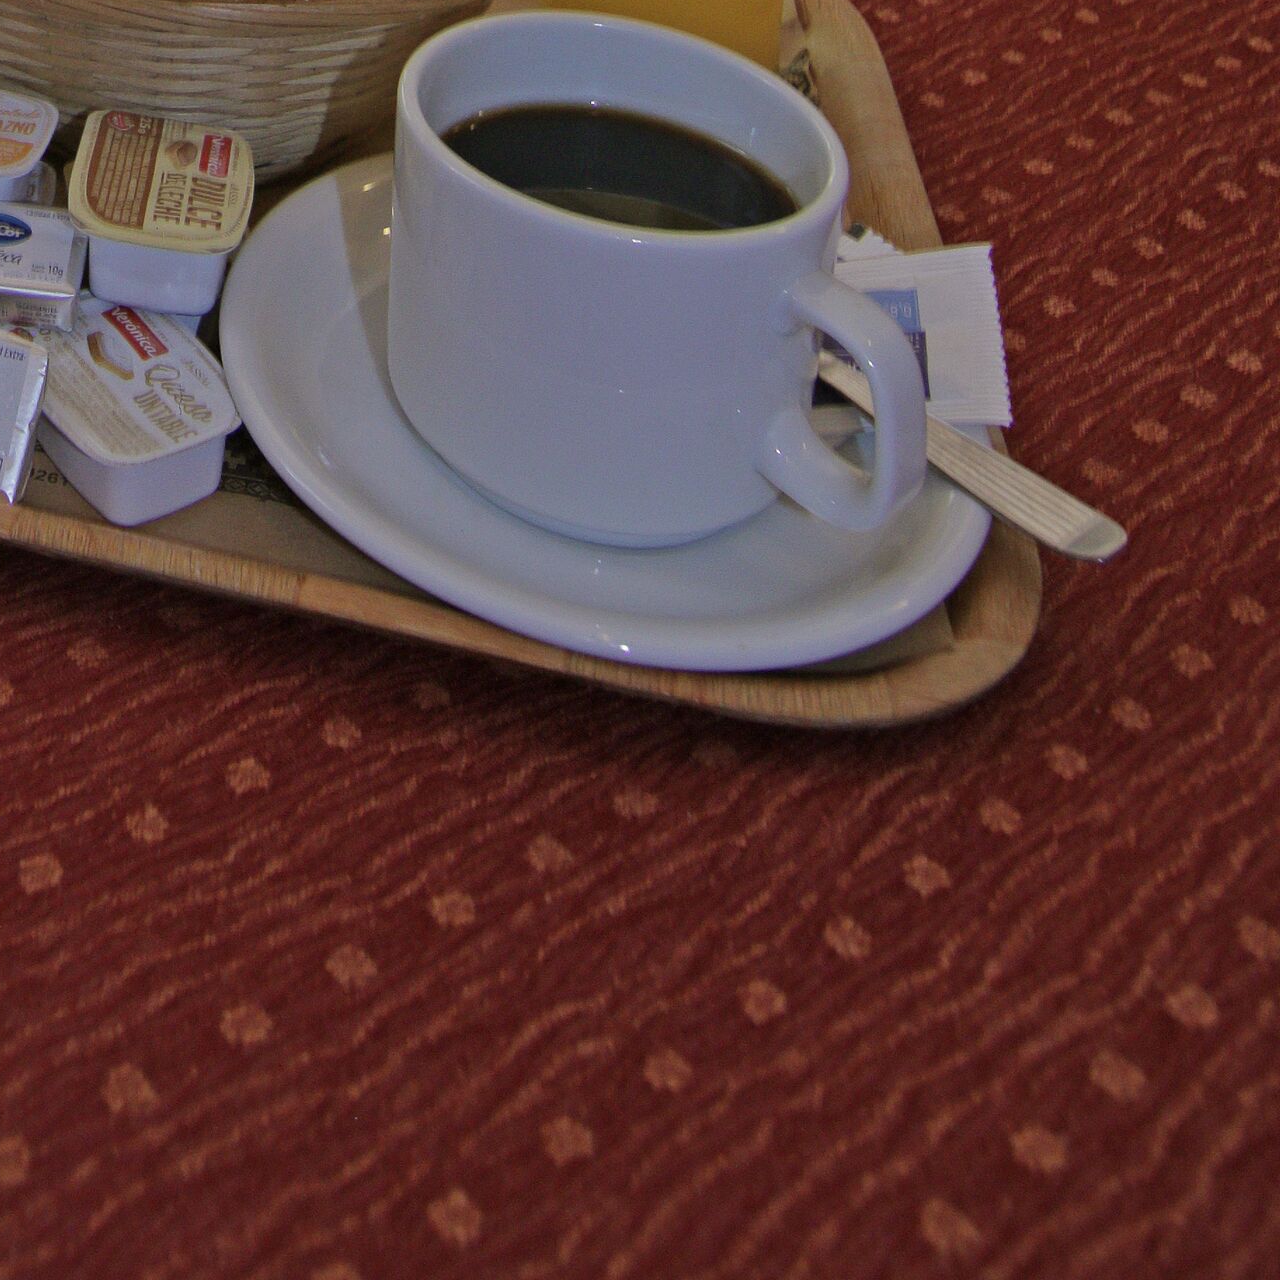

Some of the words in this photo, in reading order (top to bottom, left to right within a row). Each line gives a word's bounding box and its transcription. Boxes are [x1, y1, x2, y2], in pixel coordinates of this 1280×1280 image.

[153, 184, 185, 225] LECHE
[184, 176, 227, 231] DULCE
[111, 306, 157, 358] Verónica
[133, 390, 198, 444] UNTABLE
[144, 364, 213, 424] Queso
